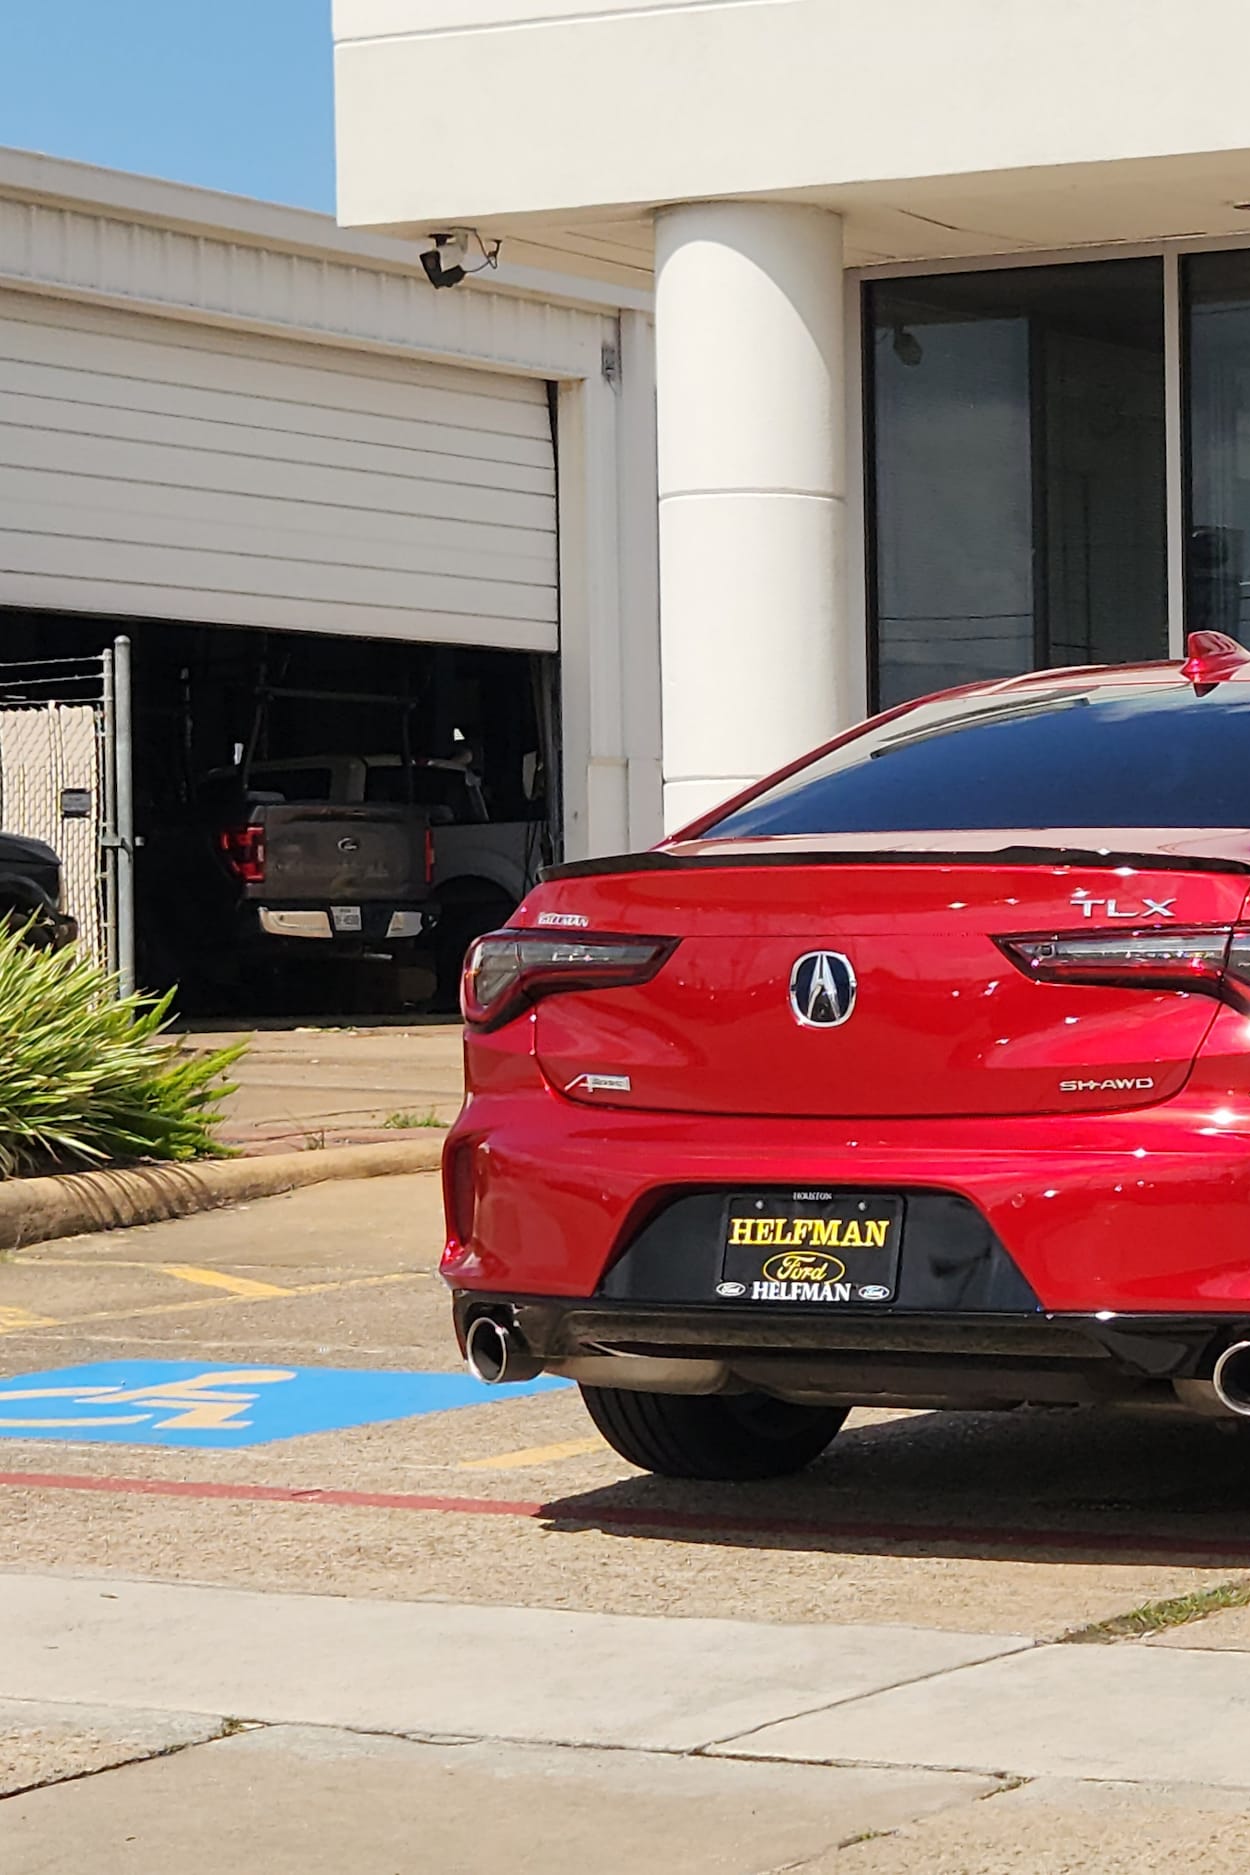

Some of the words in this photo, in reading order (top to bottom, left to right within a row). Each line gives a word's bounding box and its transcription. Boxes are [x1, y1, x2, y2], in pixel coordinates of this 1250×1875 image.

[1070, 898, 1177, 918] TLX
[728, 1218, 890, 1248] HELFMAN
[776, 1254, 829, 1281] Ford
[750, 1281, 852, 1302] HELFMAN
